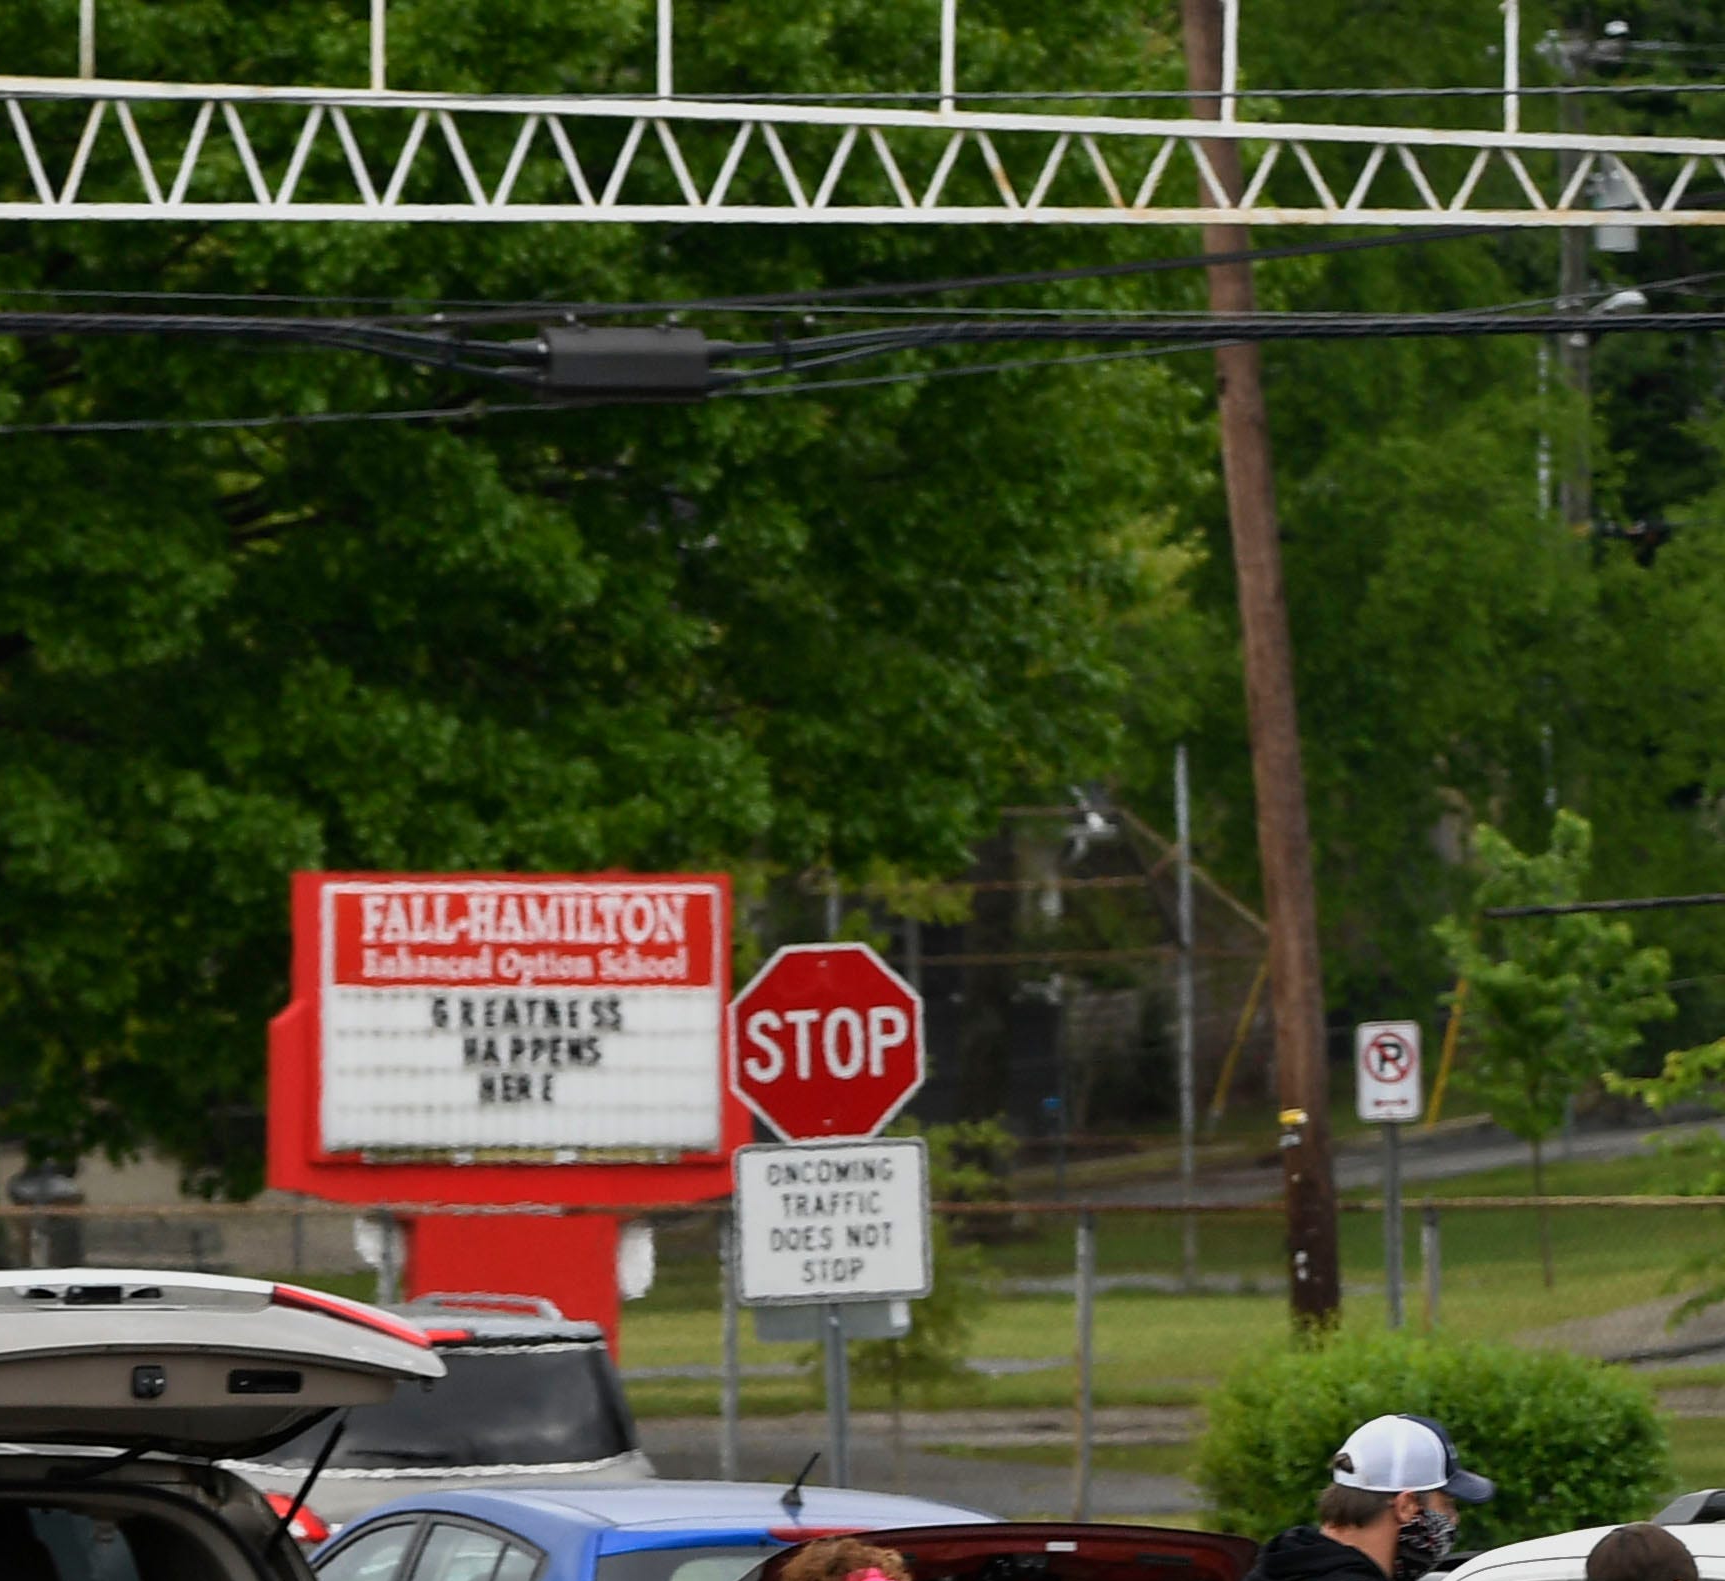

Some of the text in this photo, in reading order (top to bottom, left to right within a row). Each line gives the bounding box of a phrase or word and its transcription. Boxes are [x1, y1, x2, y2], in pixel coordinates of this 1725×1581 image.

[361, 895, 687, 944] FALL-HAMILTON
[361, 946, 688, 985] Enhanced Option School
[431, 998, 623, 1032] GREATNESS
[463, 1036, 602, 1067] HAPPENS
[747, 1006, 909, 1083] STOP
[479, 1073, 556, 1102] HERE
[766, 1157, 894, 1187] ONCOMING
[781, 1190, 882, 1218] TRAFFIC
[770, 1221, 892, 1253] DOES NOT
[802, 1257, 865, 1283] STOP
